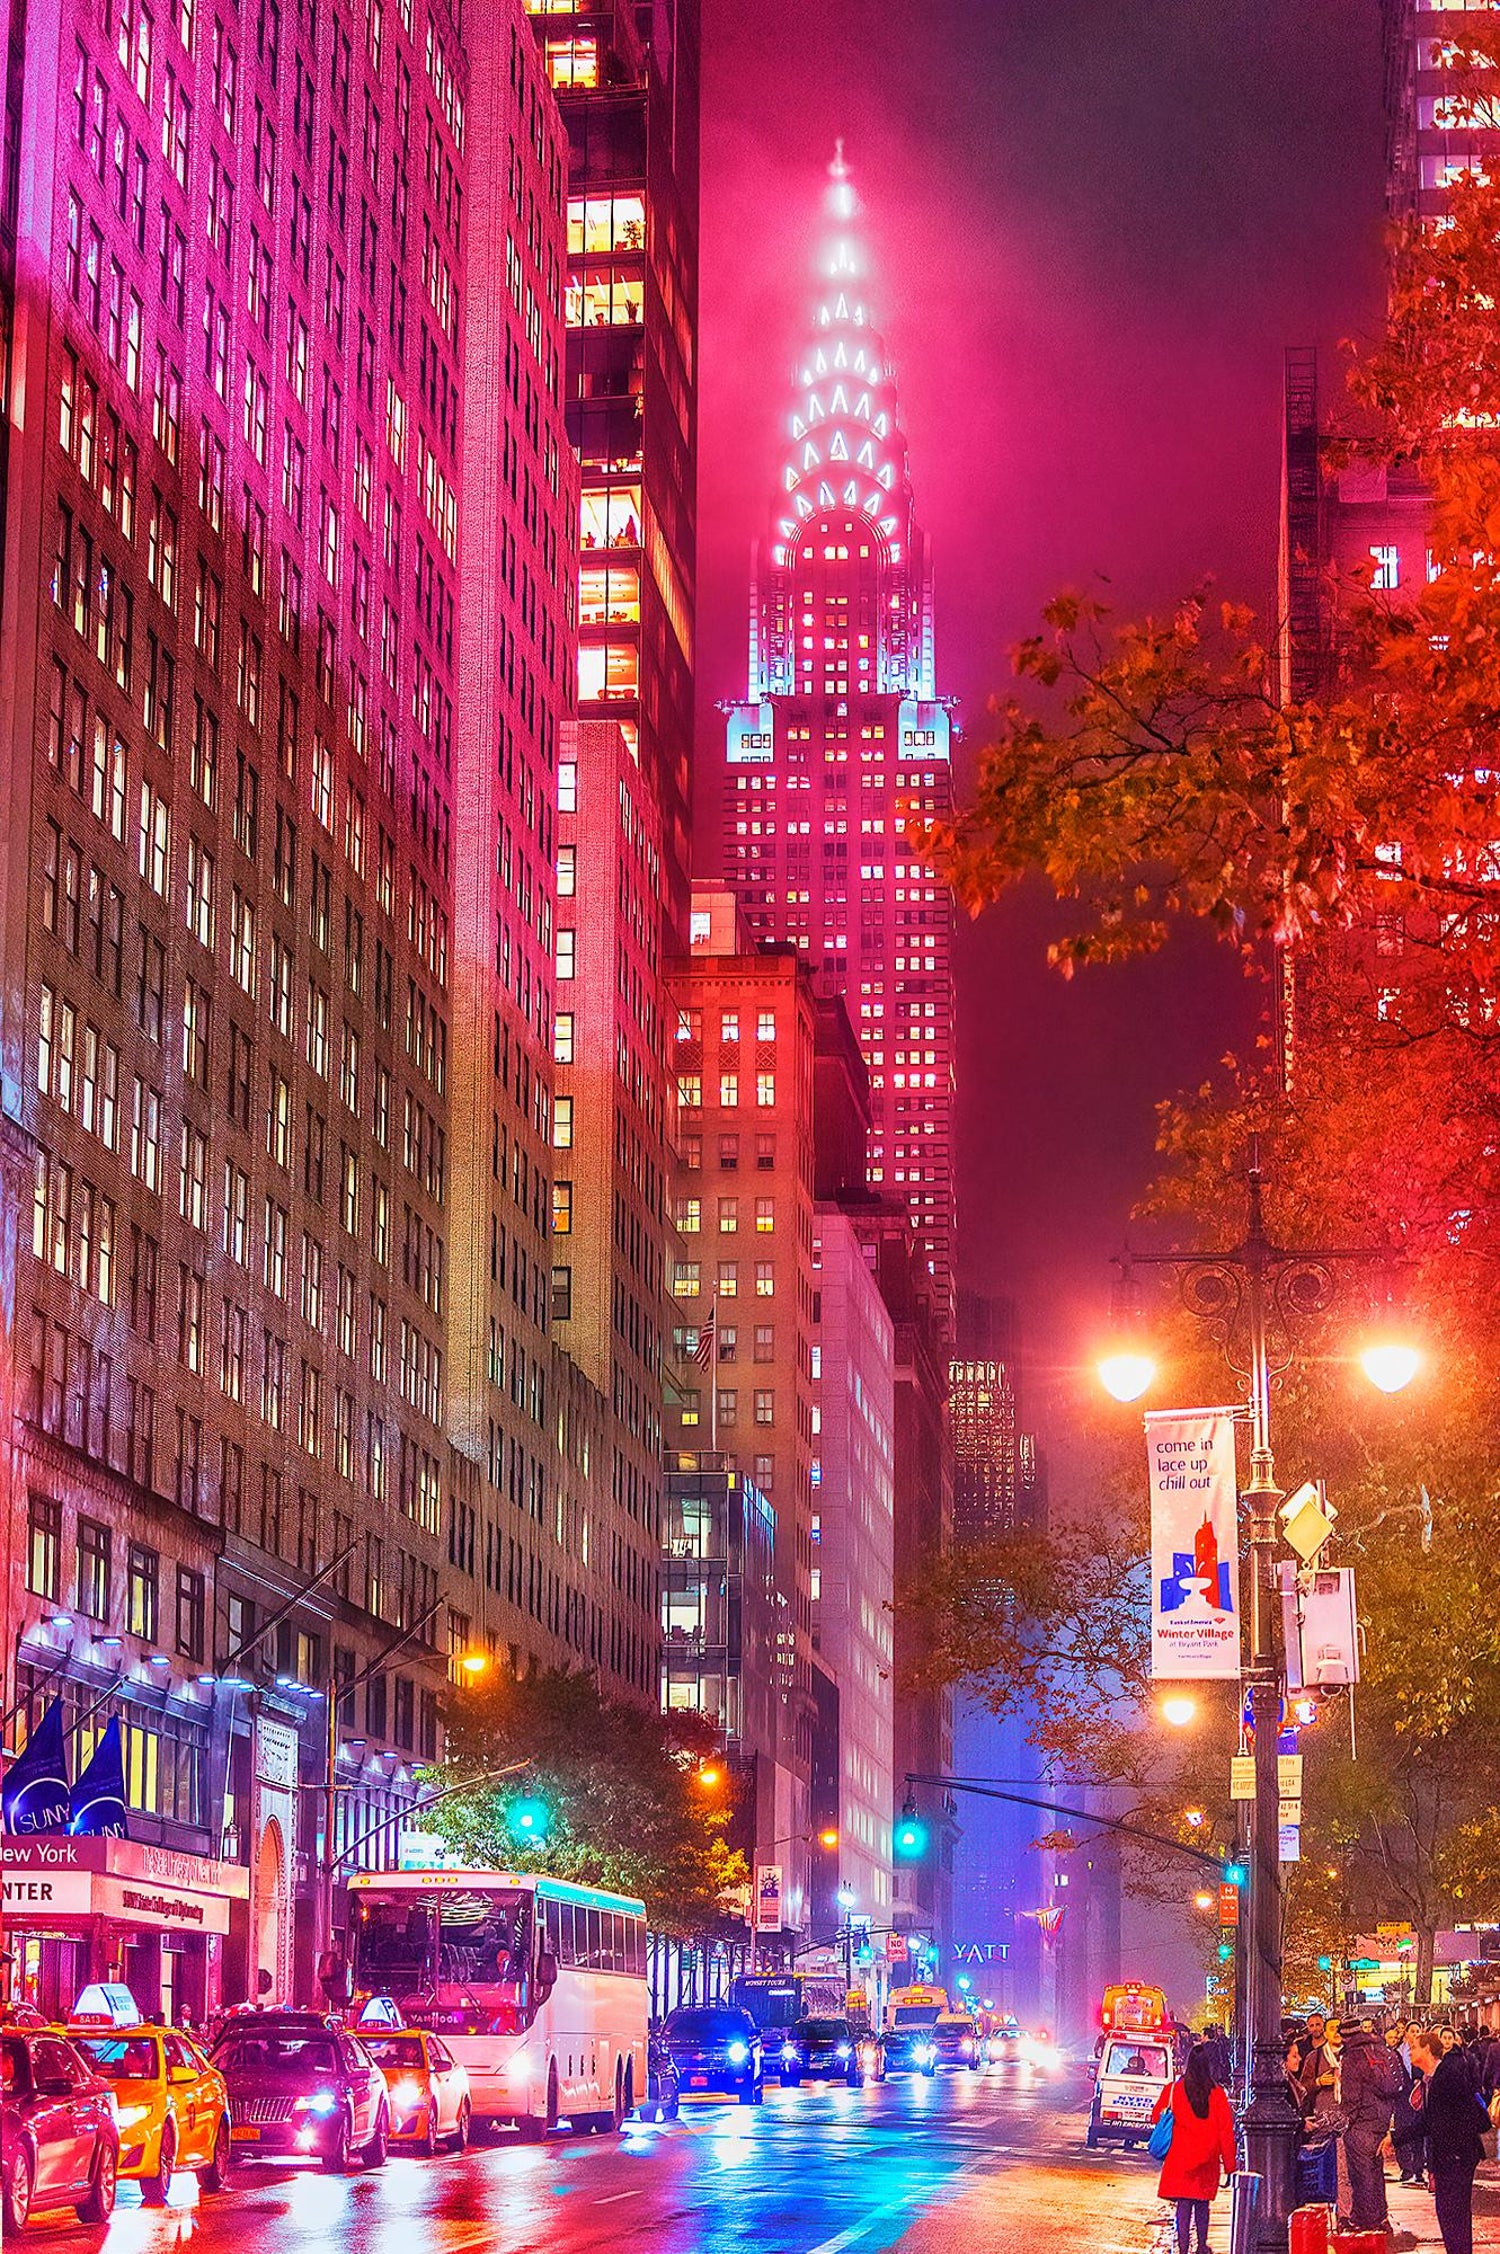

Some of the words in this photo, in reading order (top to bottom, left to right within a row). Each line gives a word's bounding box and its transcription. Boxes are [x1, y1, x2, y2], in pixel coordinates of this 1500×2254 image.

[1157, 1441, 1196, 1453] come
[1201, 1437, 1213, 1450] in
[1158, 1459, 1186, 1472] lace
[1190, 1459, 1208, 1473] up
[1159, 1475, 1185, 1490] chill
[1189, 1477, 1211, 1489] out
[1157, 1629, 1195, 1638] Winter
[1196, 1629, 1234, 1641] Village
[20, 1802, 70, 1834] SUNY
[36, 1843, 78, 1863] York
